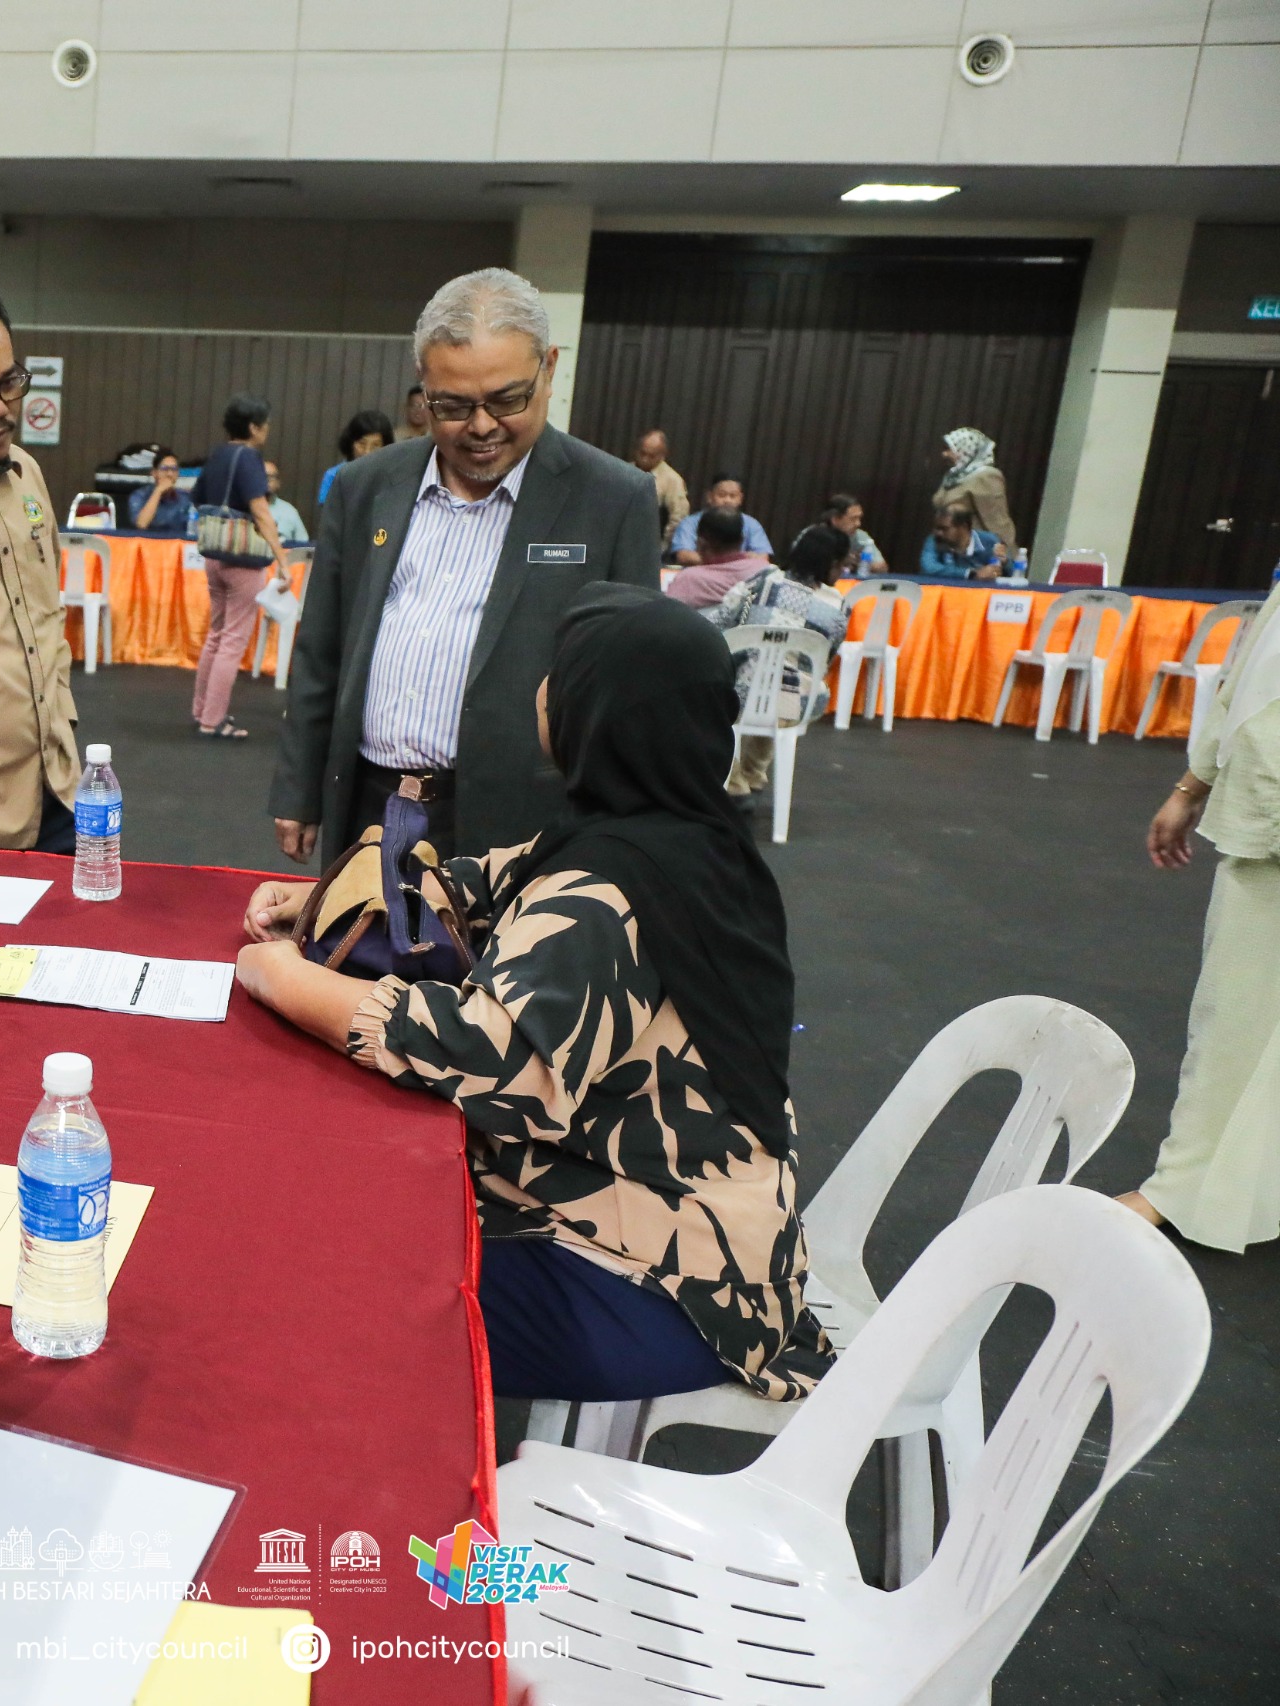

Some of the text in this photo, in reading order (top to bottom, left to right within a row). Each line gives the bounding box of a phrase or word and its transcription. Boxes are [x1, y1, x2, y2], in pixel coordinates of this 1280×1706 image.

[544, 549, 570, 557] RUMAIZI
[994, 601, 1024, 613] PPB
[762, 631, 790, 643] MBI
